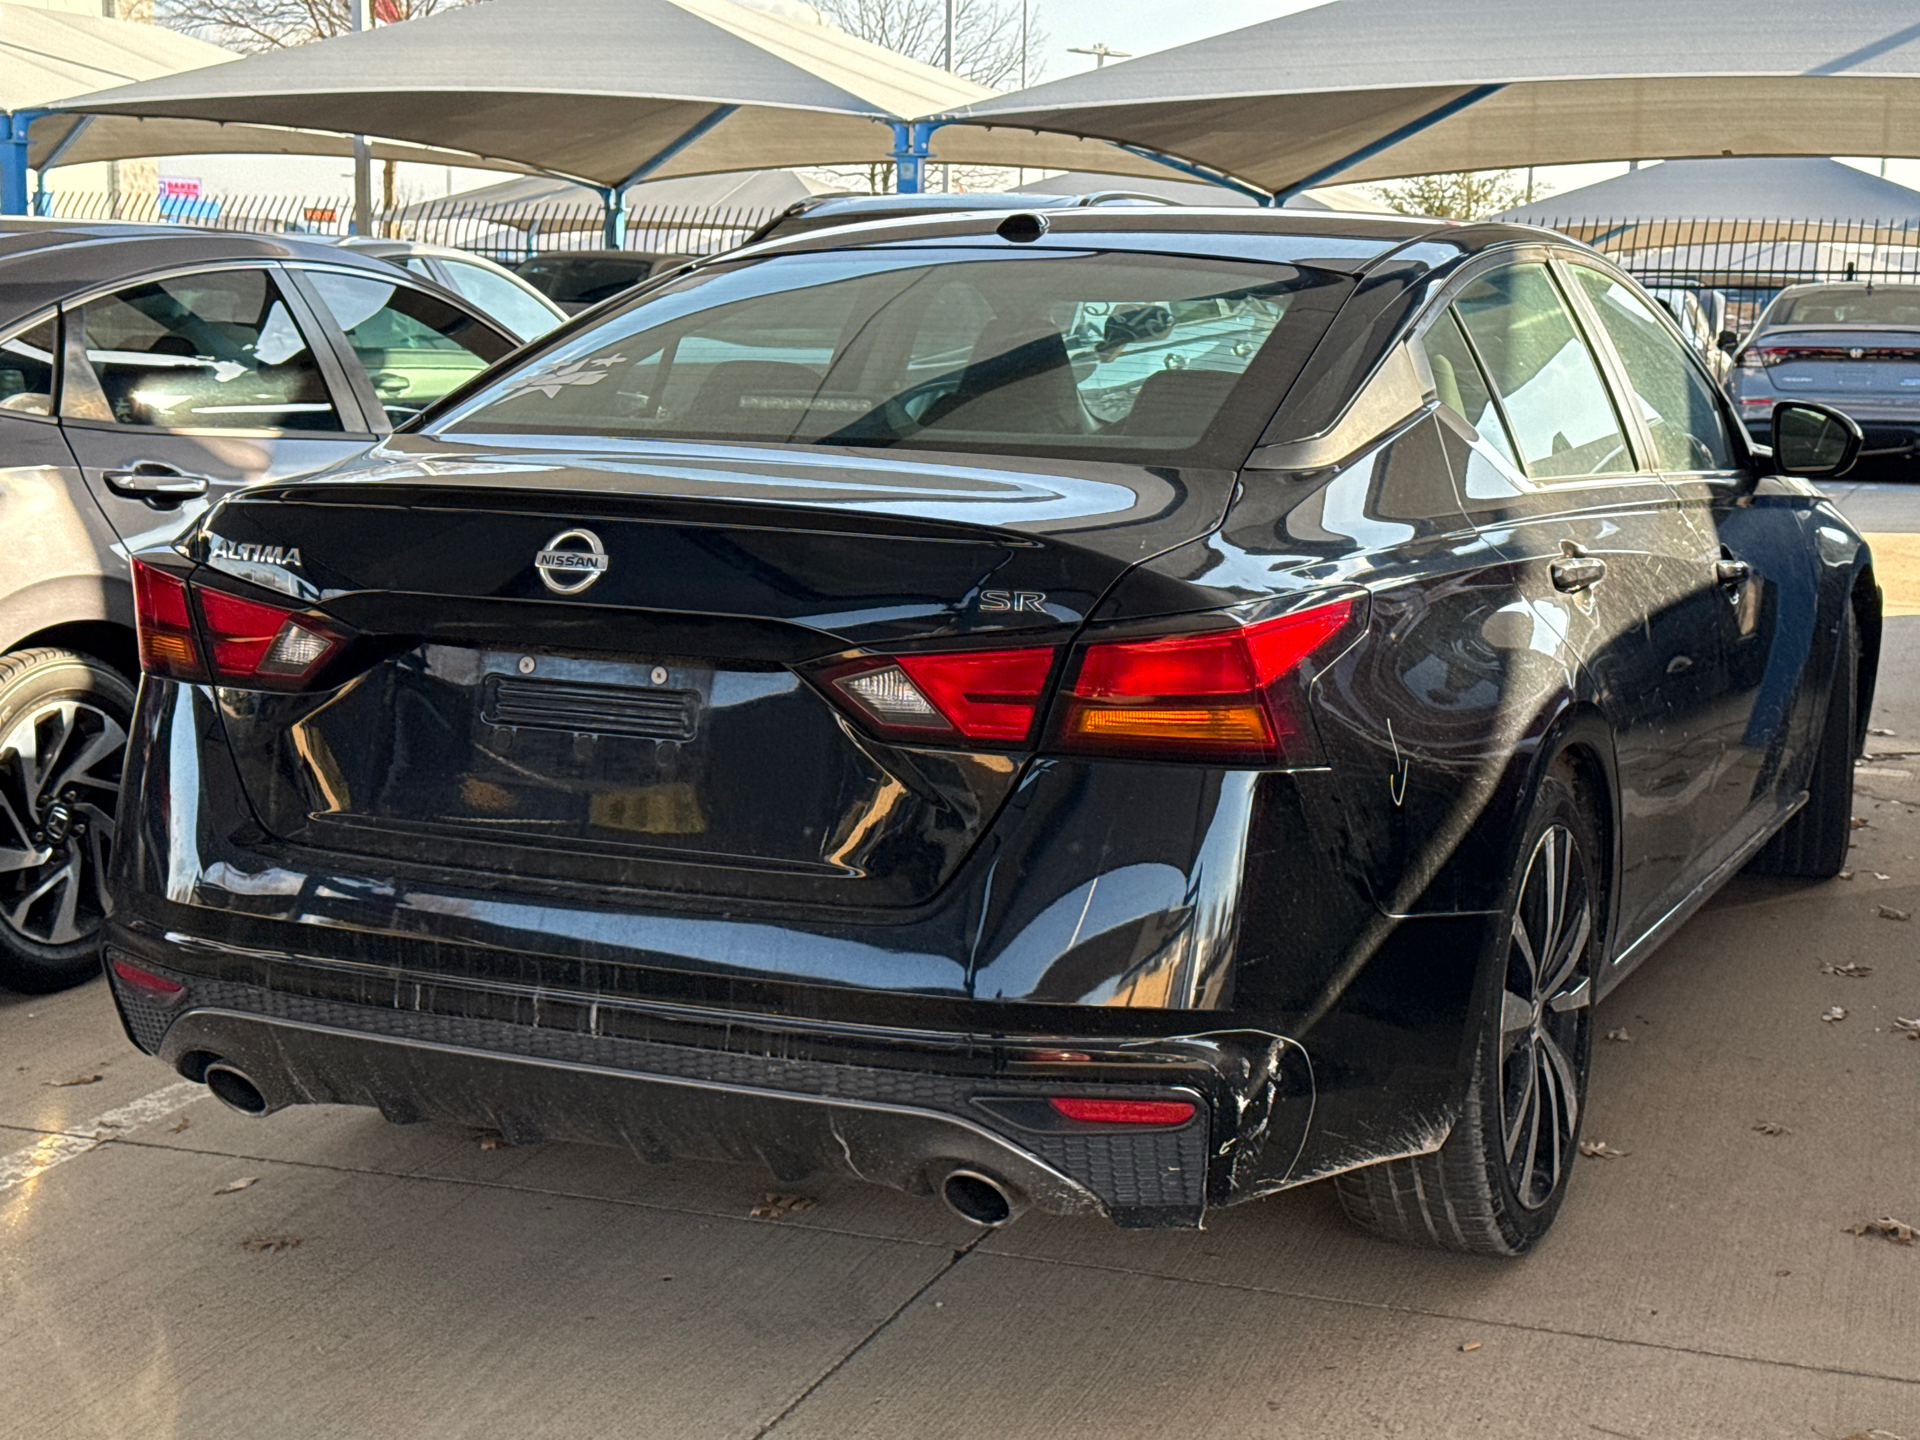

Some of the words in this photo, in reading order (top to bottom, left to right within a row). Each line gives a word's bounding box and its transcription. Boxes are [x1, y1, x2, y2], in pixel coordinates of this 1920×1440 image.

[211, 540, 302, 567] ALTIMA
[541, 554, 598, 568] NISSAN
[980, 589, 1047, 613] SR
